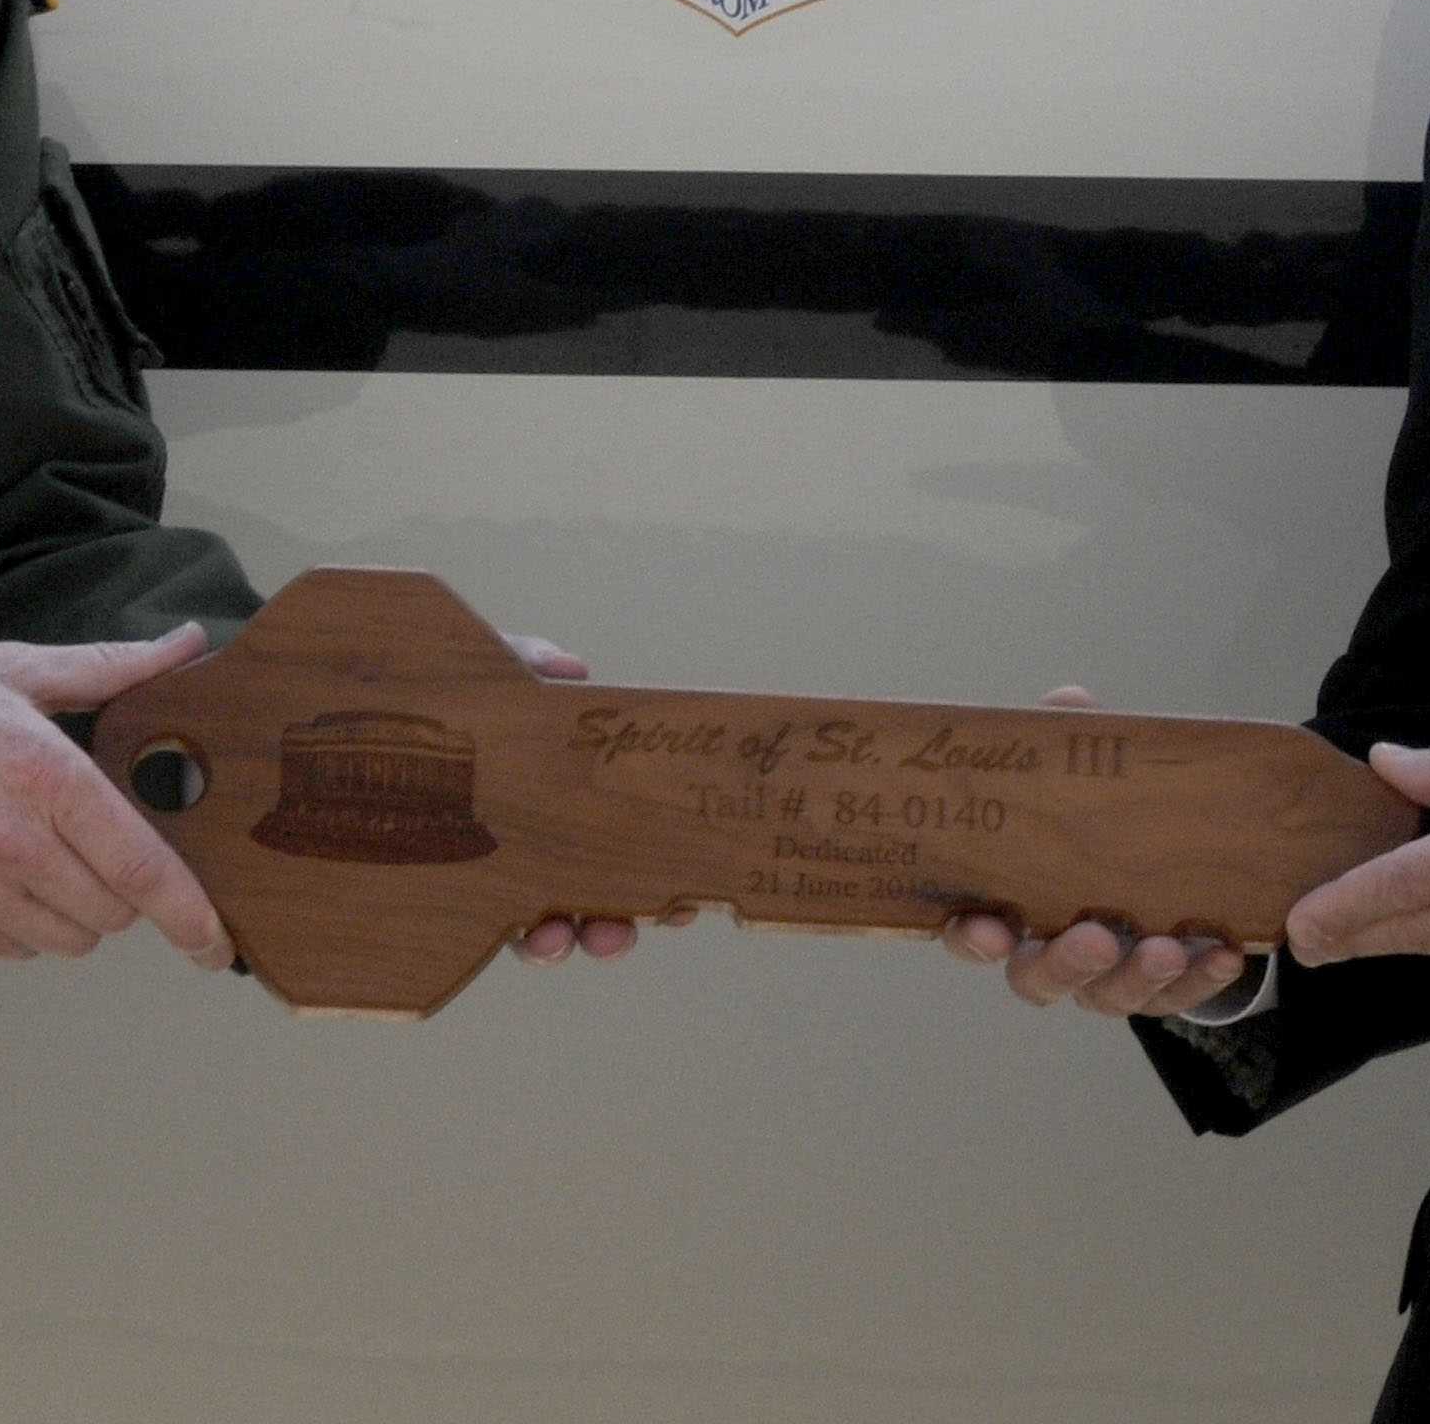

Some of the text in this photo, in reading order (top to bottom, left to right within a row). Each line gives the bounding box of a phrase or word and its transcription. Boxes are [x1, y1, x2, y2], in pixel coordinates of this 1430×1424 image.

[567, 707, 1132, 779] Spirit of St. Louis III
[687, 781, 766, 819] Tail
[778, 786, 807, 823] #
[774, 836, 918, 867] Dedicated
[747, 870, 779, 895] 21
[793, 872, 857, 898] June
